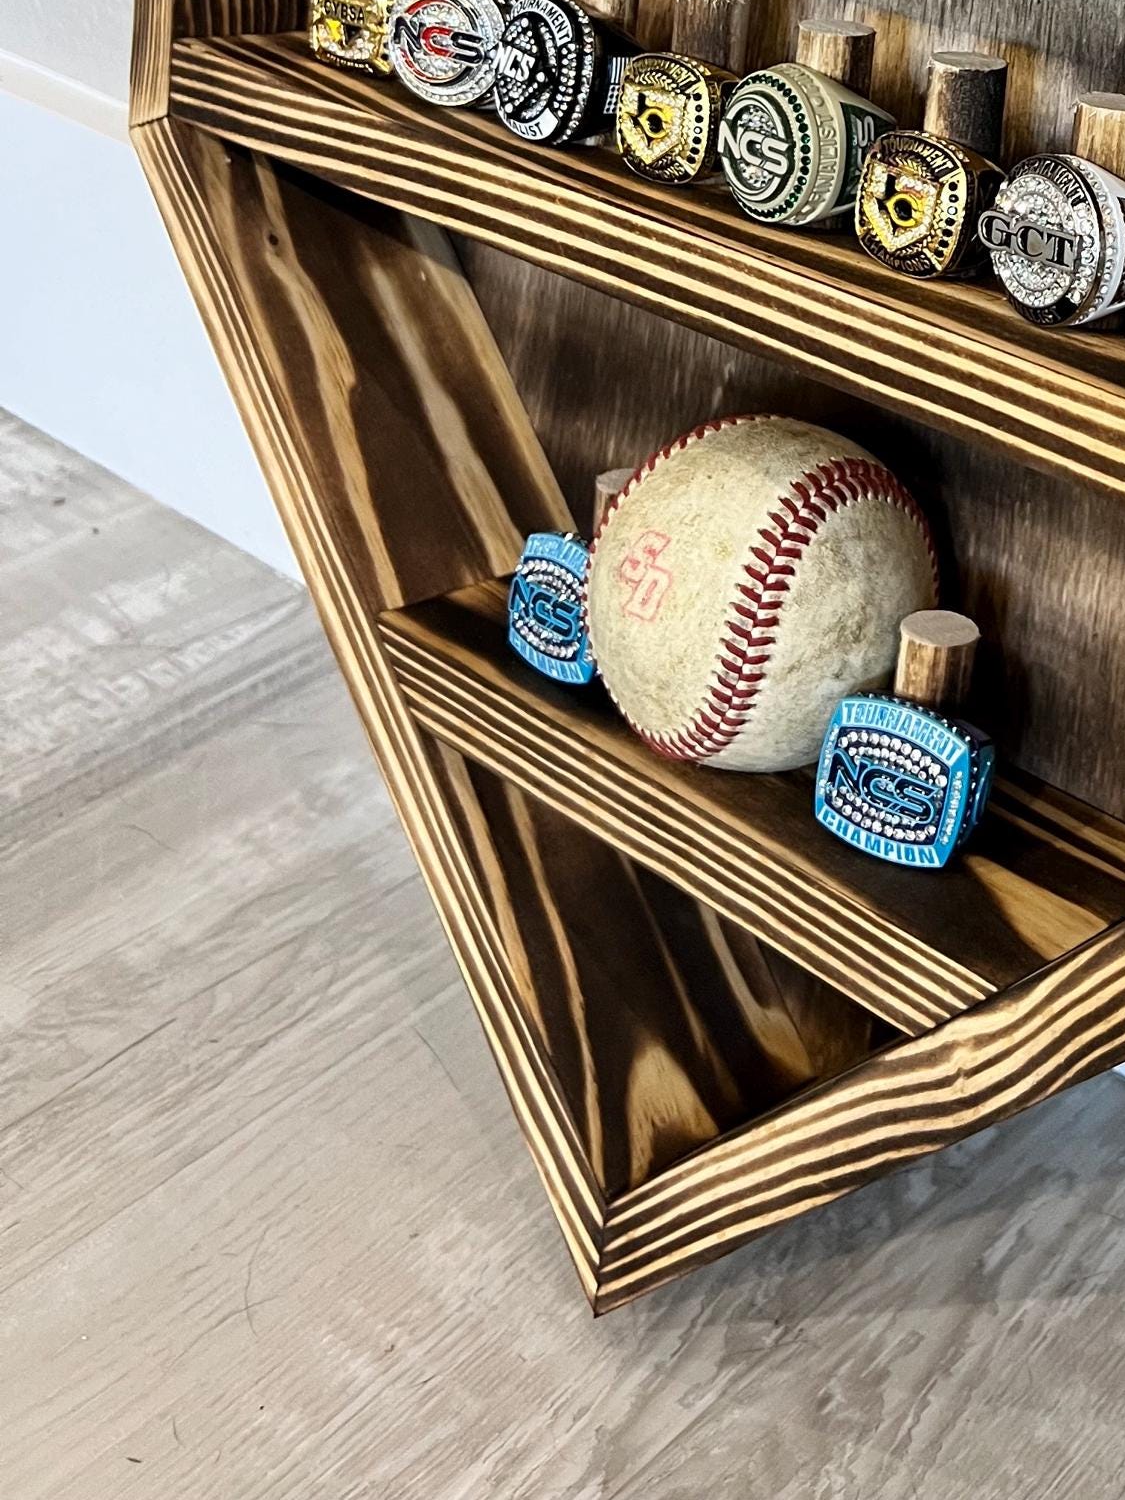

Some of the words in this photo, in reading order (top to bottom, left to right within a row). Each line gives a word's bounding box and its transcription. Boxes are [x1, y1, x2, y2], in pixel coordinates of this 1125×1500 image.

[393, 16, 484, 65] NCS
[492, 40, 536, 83] NCS
[717, 120, 790, 176] NCS
[809, 115, 838, 201] FINALIST
[864, 234, 932, 272] CHAMPIONS
[979, 214, 1075, 268] GCT
[509, 575, 580, 640] NCS
[842, 700, 963, 762] TOURNAMENT
[826, 749, 940, 823] NCS
[821, 808, 938, 865] CHAMPION
